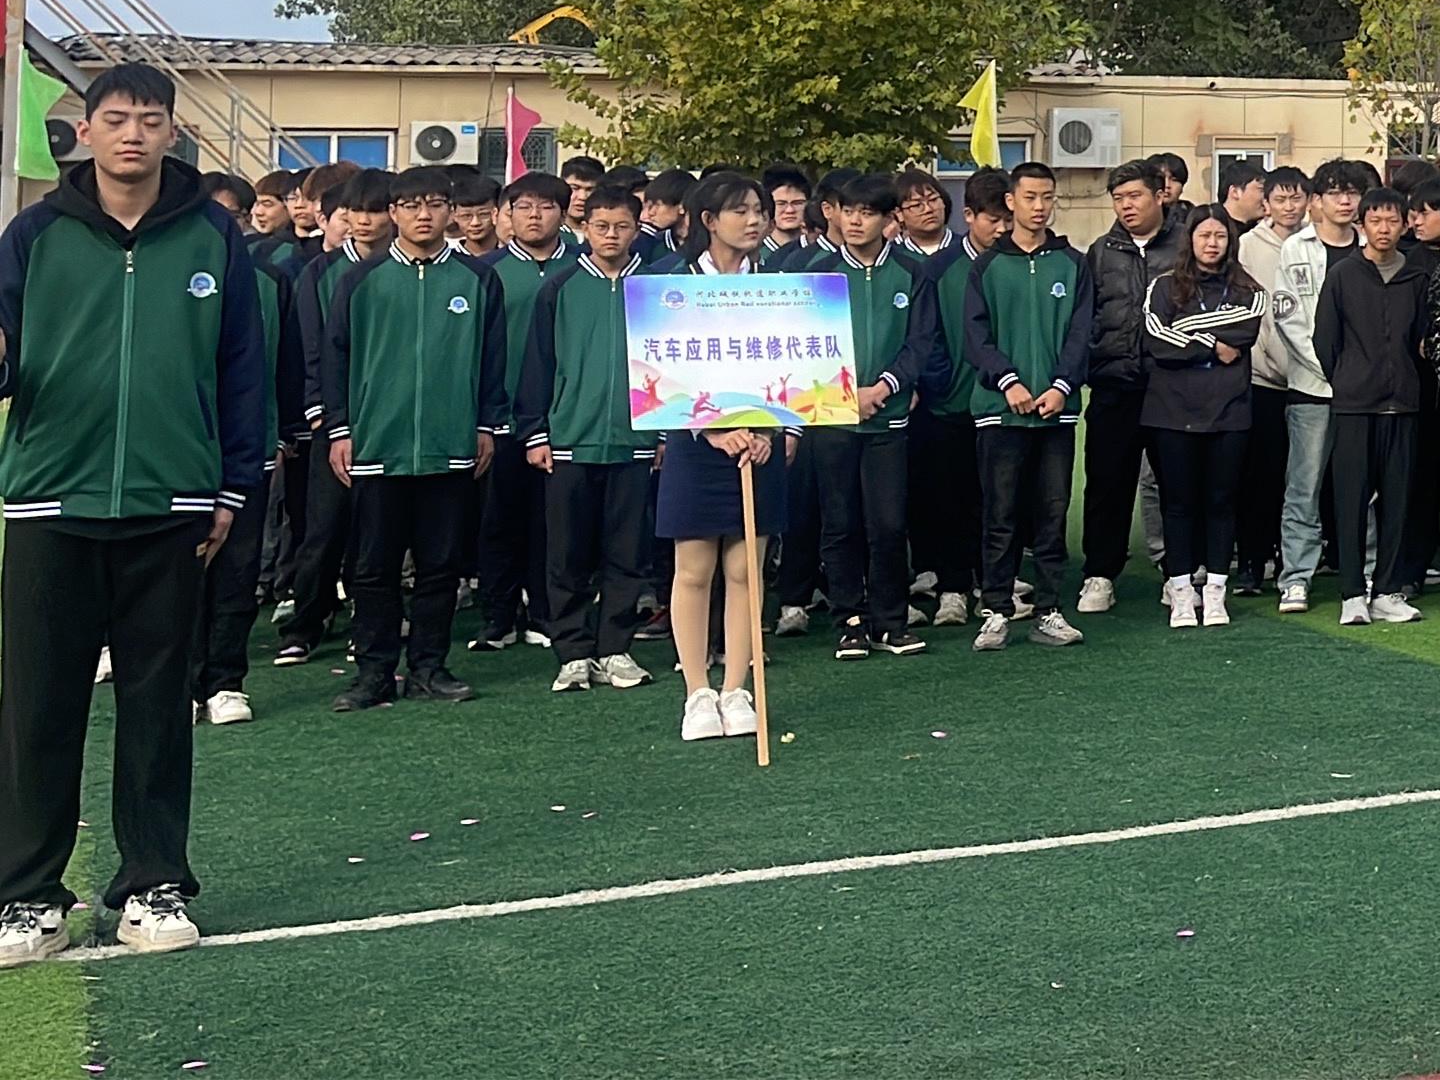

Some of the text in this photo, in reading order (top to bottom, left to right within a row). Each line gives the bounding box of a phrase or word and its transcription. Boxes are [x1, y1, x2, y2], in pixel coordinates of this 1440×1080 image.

[644, 335, 842, 362] 汽车应用与维修代表队
